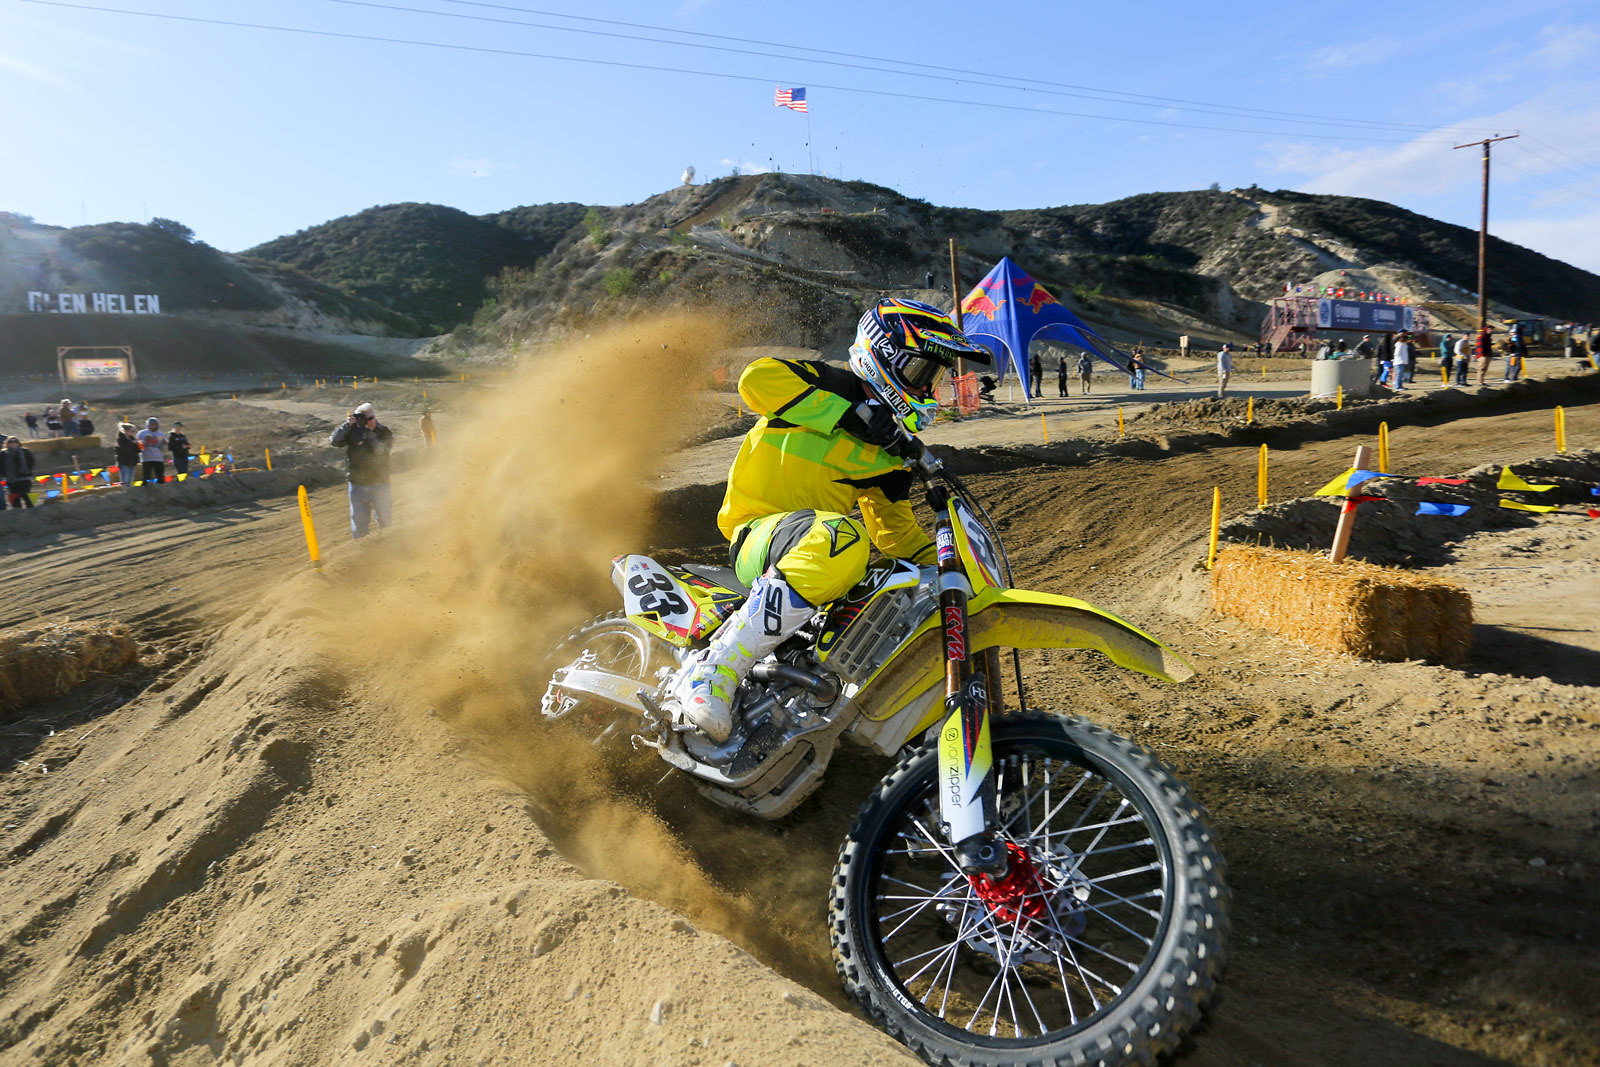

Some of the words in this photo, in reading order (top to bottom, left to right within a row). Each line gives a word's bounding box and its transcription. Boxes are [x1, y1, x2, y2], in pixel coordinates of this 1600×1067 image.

[92, 292, 160, 314] HELEN
[862, 357, 876, 377] SHOEI
[883, 384, 903, 407] HLTN
[897, 401, 912, 415] CO
[937, 532, 953, 542] STAY
[627, 573, 688, 618] 33
[945, 607, 966, 661] KYB
[948, 742, 962, 808] vonzipper
